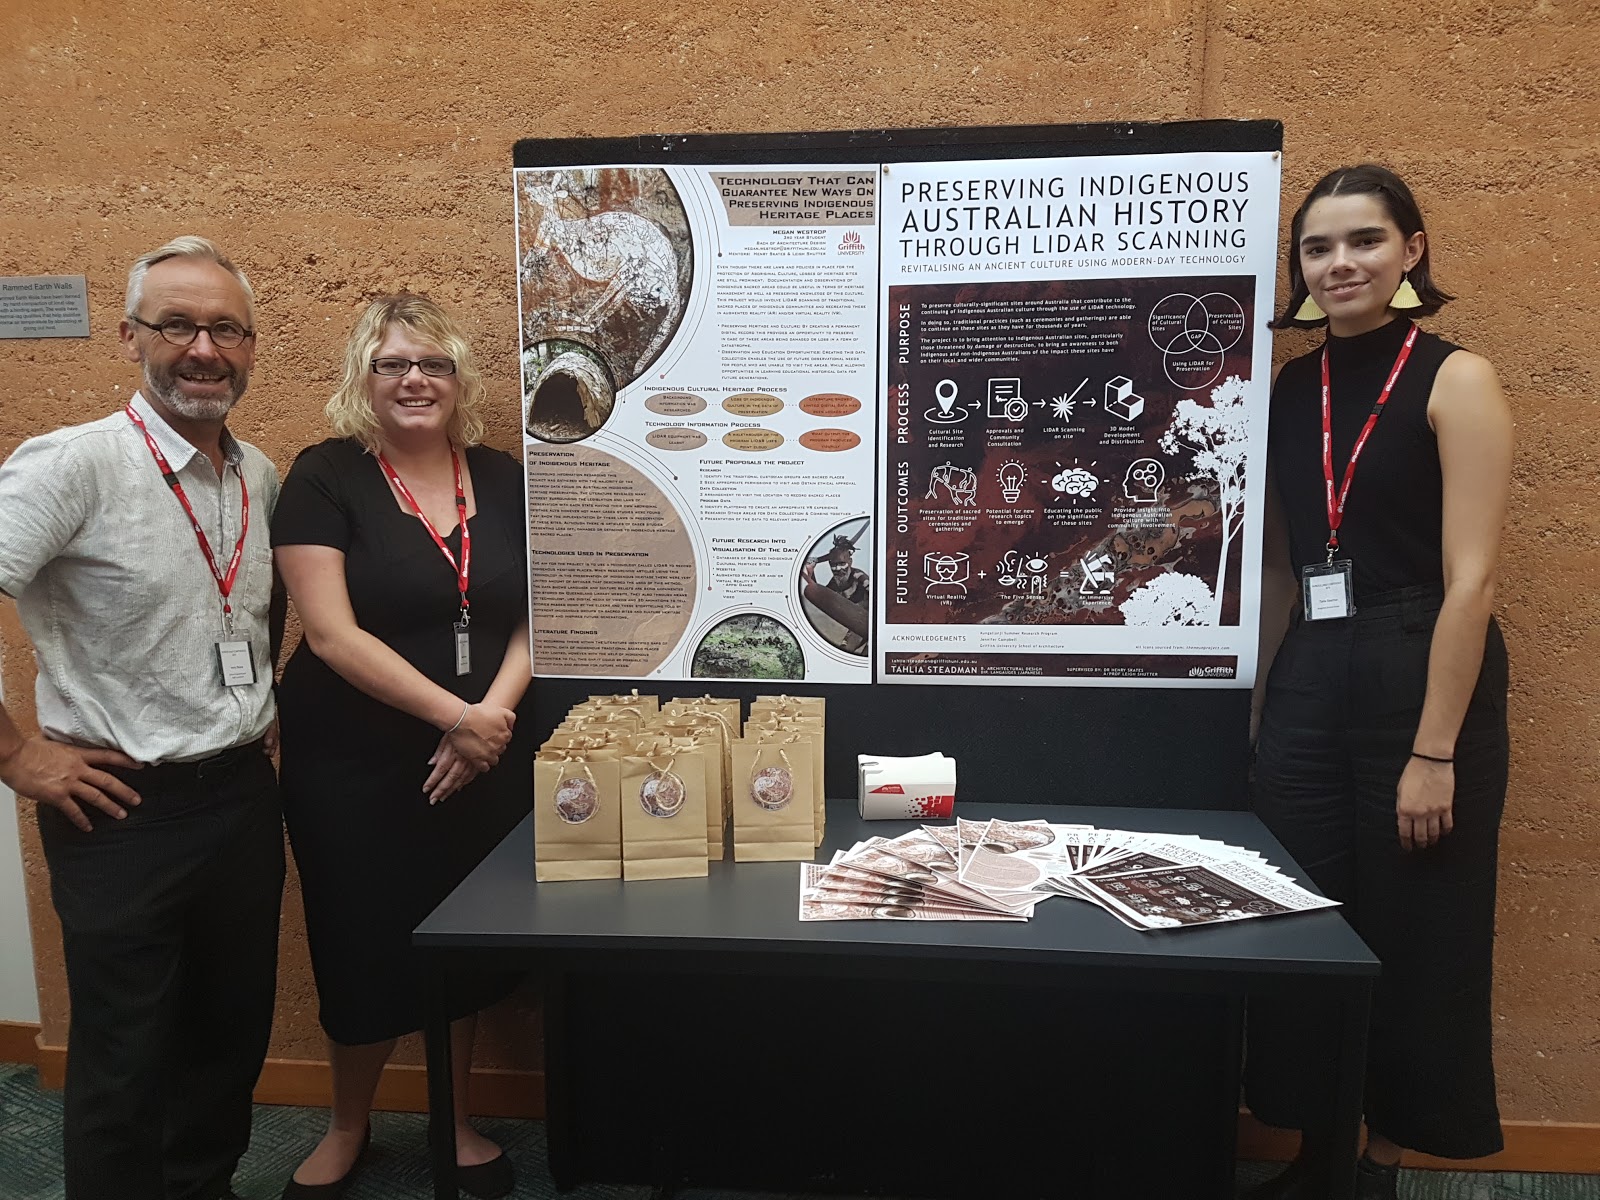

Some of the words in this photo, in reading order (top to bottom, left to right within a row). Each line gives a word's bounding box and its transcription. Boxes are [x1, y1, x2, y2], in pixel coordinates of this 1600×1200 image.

[902, 178, 1064, 203] PRESERVING
[1080, 172, 1249, 196] INDIGENOUS
[901, 204, 1096, 233] AUSTRALIAN
[1115, 199, 1249, 226] HISTORY
[838, 244, 865, 252] Griffith
[899, 236, 1019, 258] THROUGH
[1034, 233, 1103, 253] LIDAR
[1118, 229, 1246, 251] SCANNING
[902, 263, 964, 273] REVITALISING
[985, 261, 1024, 270] ANCIENT
[1030, 260, 1073, 269] CULTURE
[1078, 259, 1107, 267] USING
[1112, 257, 1175, 266] MODERN-DAY
[1181, 254, 1245, 264] TECHNOLOGY
[899, 304, 910, 363] PURPOSE
[898, 383, 909, 443] PROCESS
[898, 462, 908, 532] OUTCOMES
[897, 550, 908, 604] FUTURE
[1204, 667, 1233, 675] Griffith
